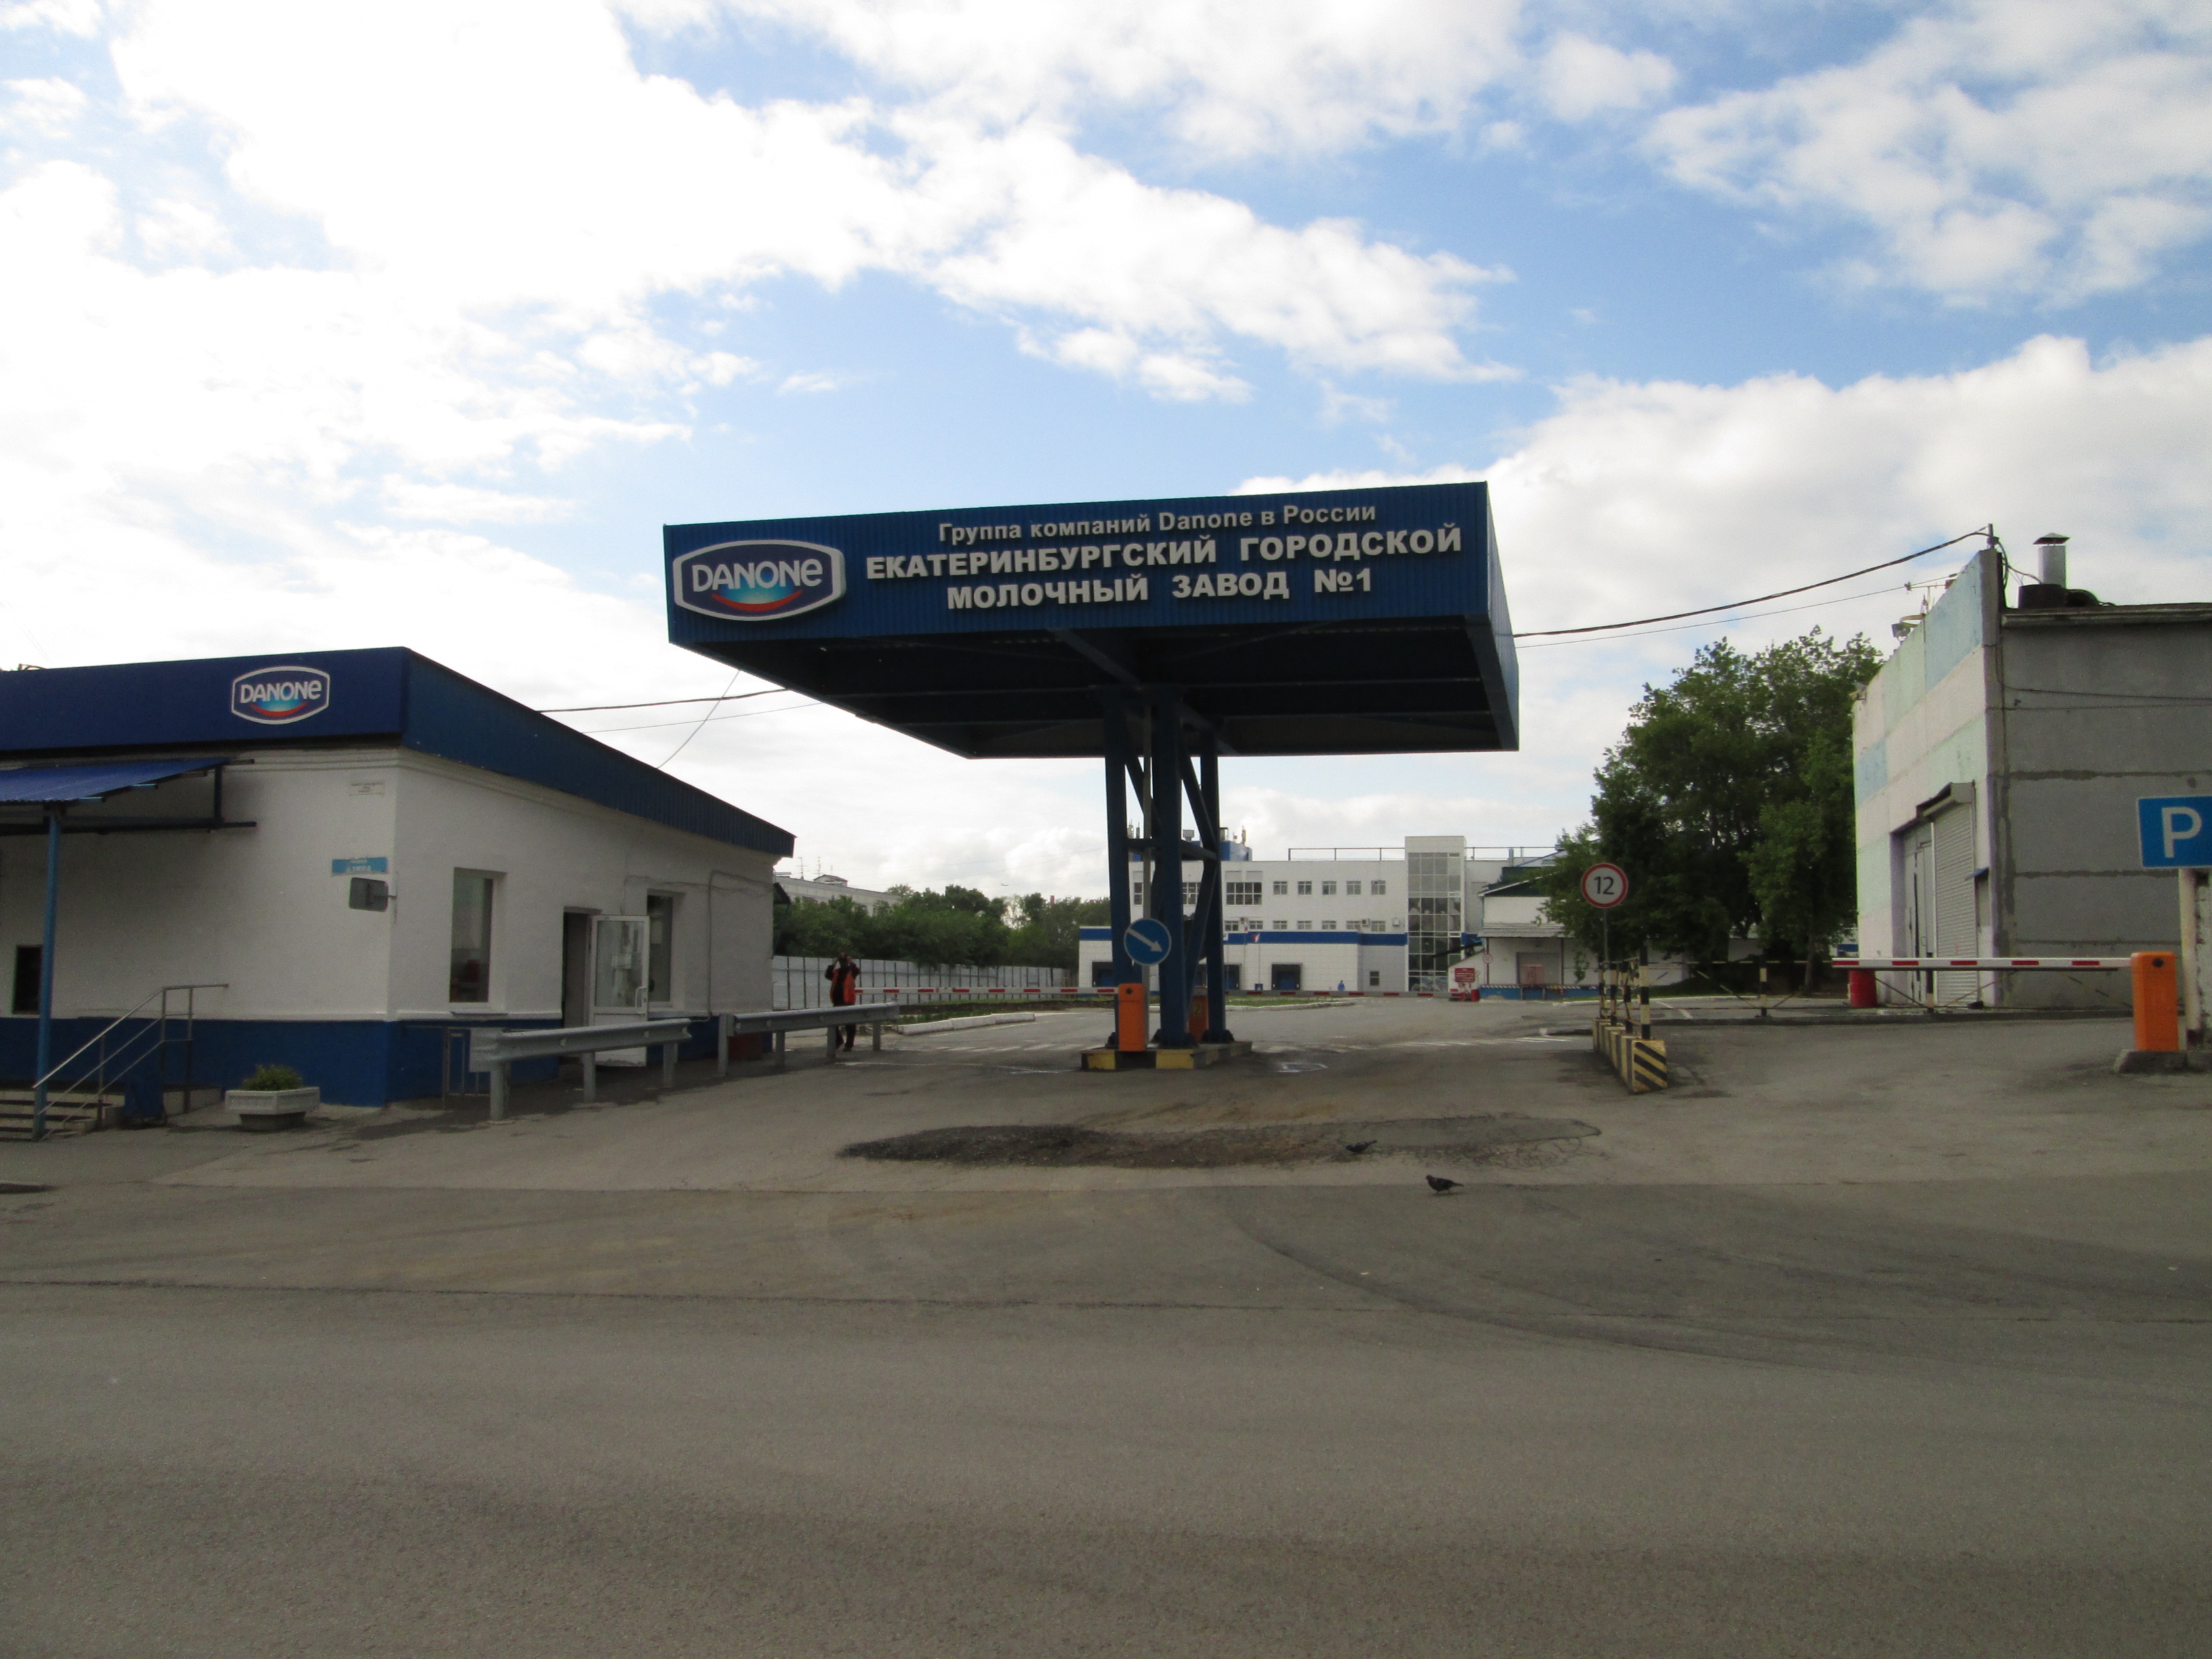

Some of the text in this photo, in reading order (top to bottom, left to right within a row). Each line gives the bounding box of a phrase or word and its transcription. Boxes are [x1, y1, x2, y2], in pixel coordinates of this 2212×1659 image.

[939, 505, 1376, 546] Группа компаний Danone в России
[866, 523, 1462, 580] ЕКАТЕРИНБУРГСКИЙ ГОРОДСКОЙ
[947, 568, 1372, 610] МОЛОЧНЫЙ ЗАВОД №1
[1593, 876, 1615, 895] 12
